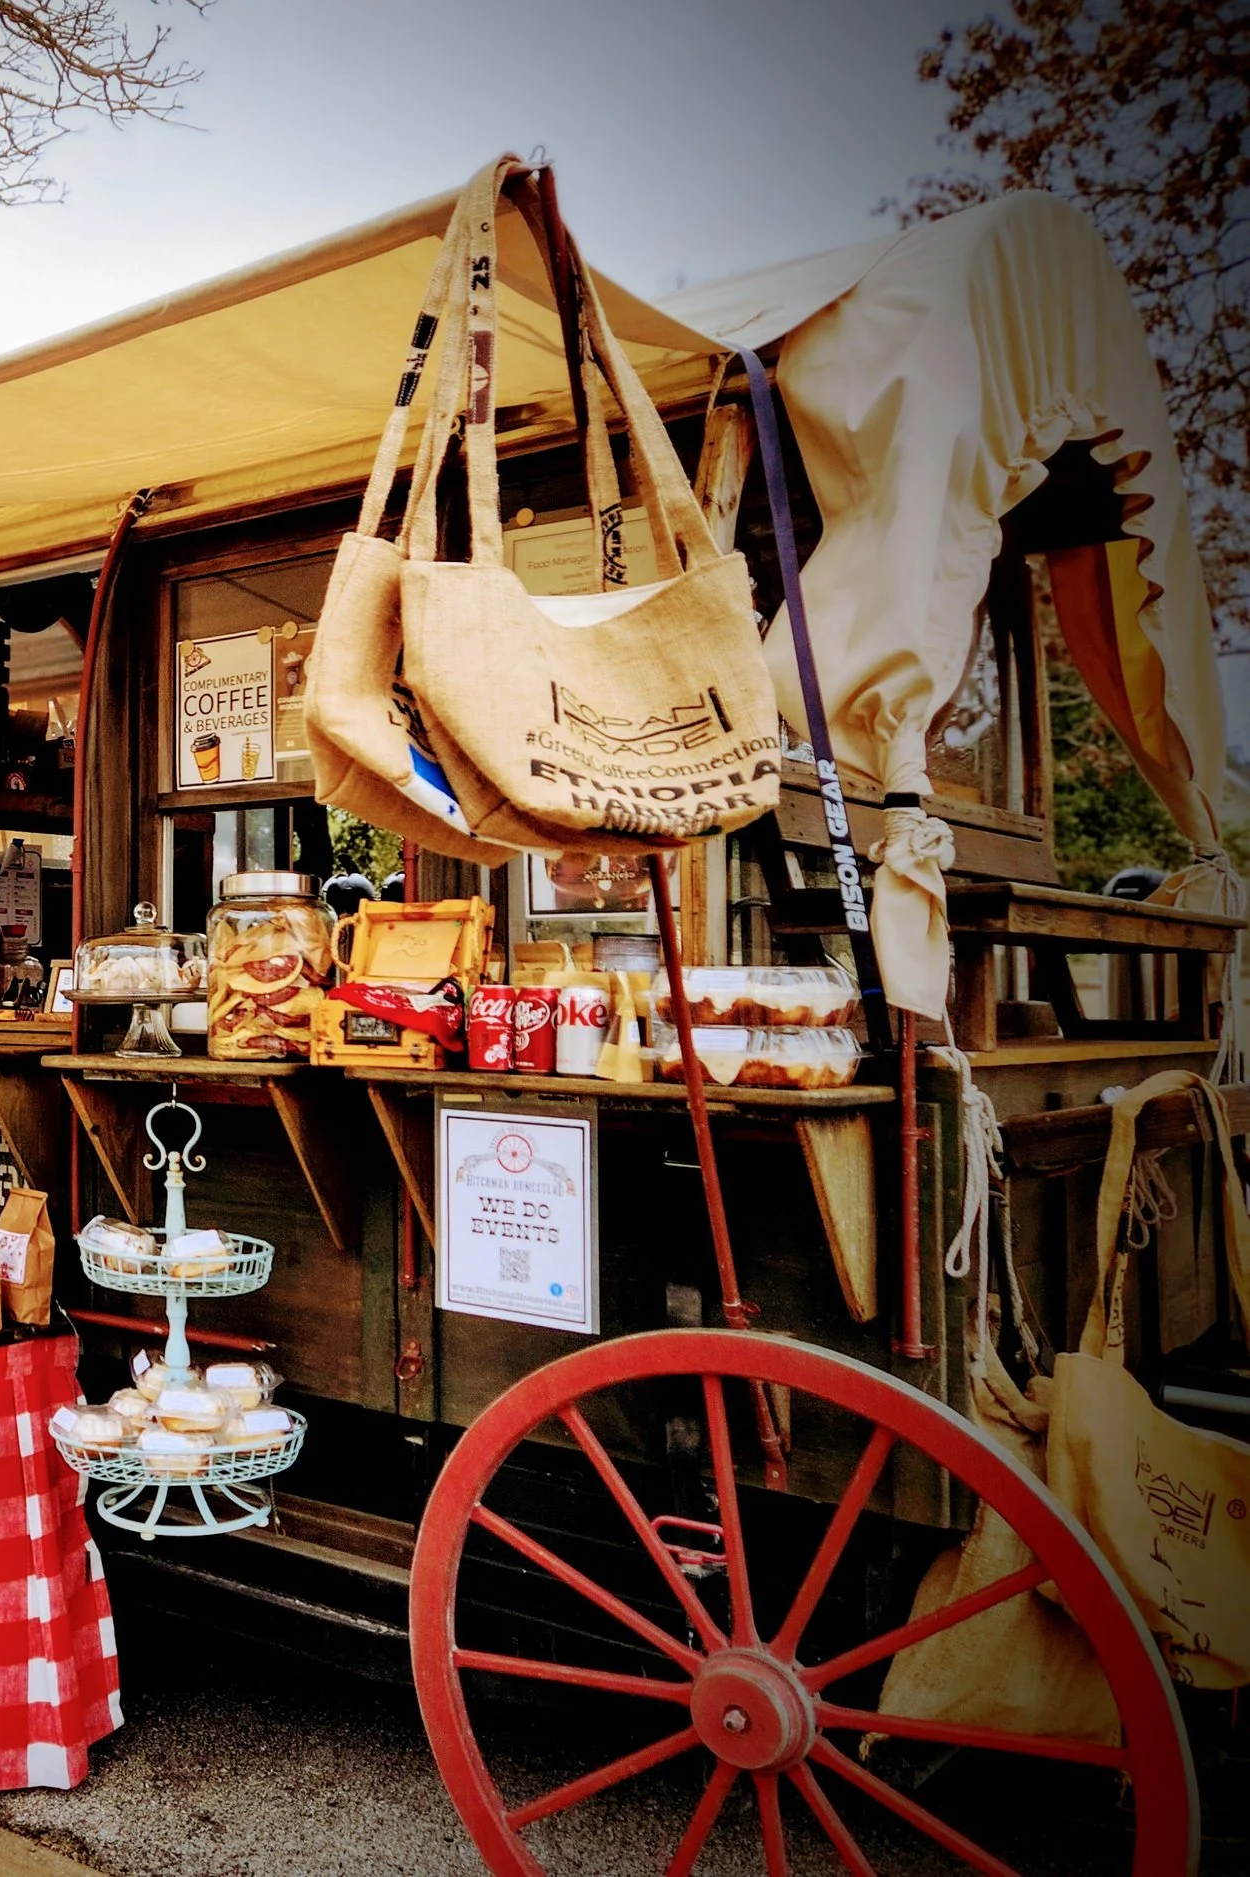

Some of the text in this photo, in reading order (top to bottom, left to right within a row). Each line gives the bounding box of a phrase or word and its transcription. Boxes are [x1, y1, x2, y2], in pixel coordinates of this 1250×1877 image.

[183, 671, 269, 692] COMPLIMENTARY
[184, 685, 268, 717] COFFEE
[560, 686, 705, 730] COPAN
[184, 711, 268, 733] & BEVERAGES
[569, 719, 718, 756] TRADE
[531, 759, 779, 801] ETHIOPIA
[817, 759, 868, 931] BISON GEAR
[479, 1196, 550, 1219] WE DO
[472, 1218, 560, 1244] EVENTS
